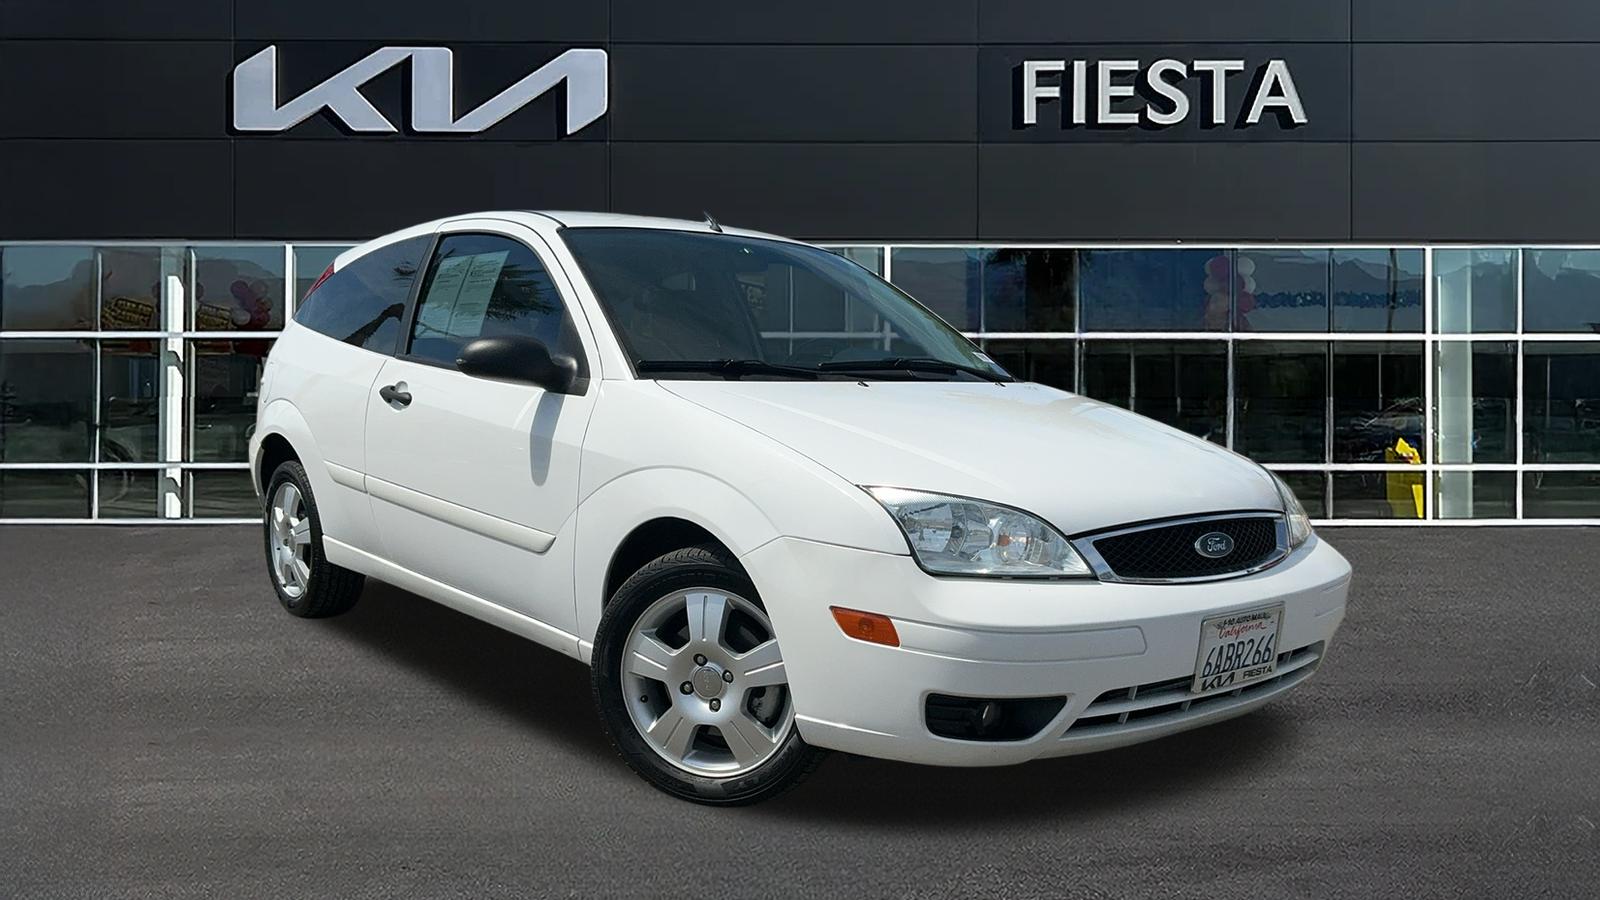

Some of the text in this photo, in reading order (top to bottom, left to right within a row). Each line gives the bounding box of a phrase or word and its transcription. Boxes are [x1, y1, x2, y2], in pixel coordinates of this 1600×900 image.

[233, 45, 608, 135] KIA
[1024, 59, 1308, 125] FIESTA
[1207, 537, 1226, 552] Ford
[1219, 622, 1267, 640] California
[1202, 633, 1274, 677] 6ABR266
[1201, 665, 1272, 691] KIA FIESTA
